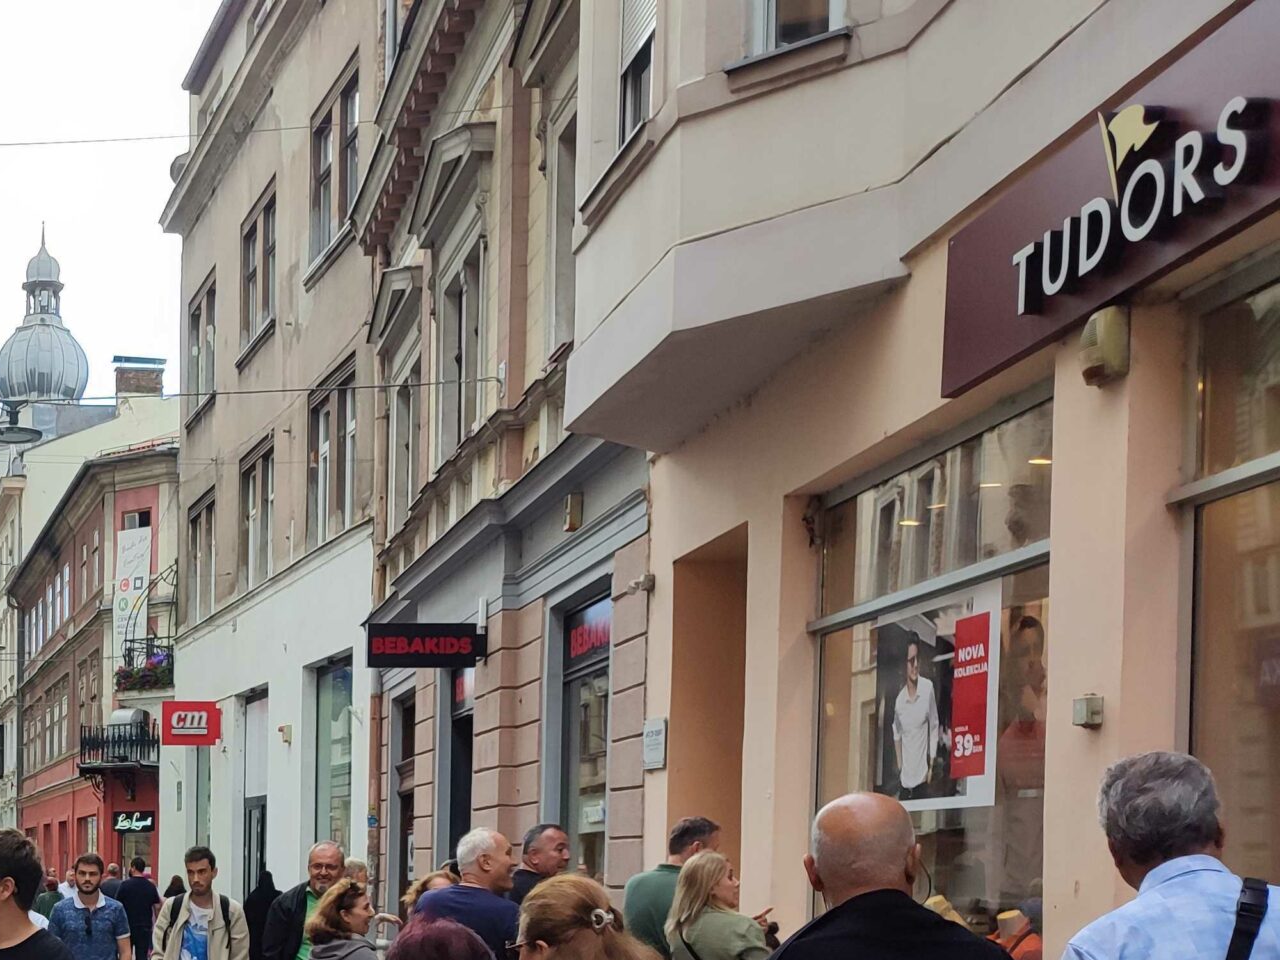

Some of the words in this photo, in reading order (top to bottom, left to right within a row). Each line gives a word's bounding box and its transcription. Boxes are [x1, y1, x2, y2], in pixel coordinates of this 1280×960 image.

[1012, 96, 1248, 316] TUDORS
[371, 636, 473, 654] BEBAKIDS
[958, 643, 985, 663] NOVA
[954, 662, 988, 679] KOLEKCIJA
[171, 711, 208, 728] cm
[954, 733, 973, 758] 39
